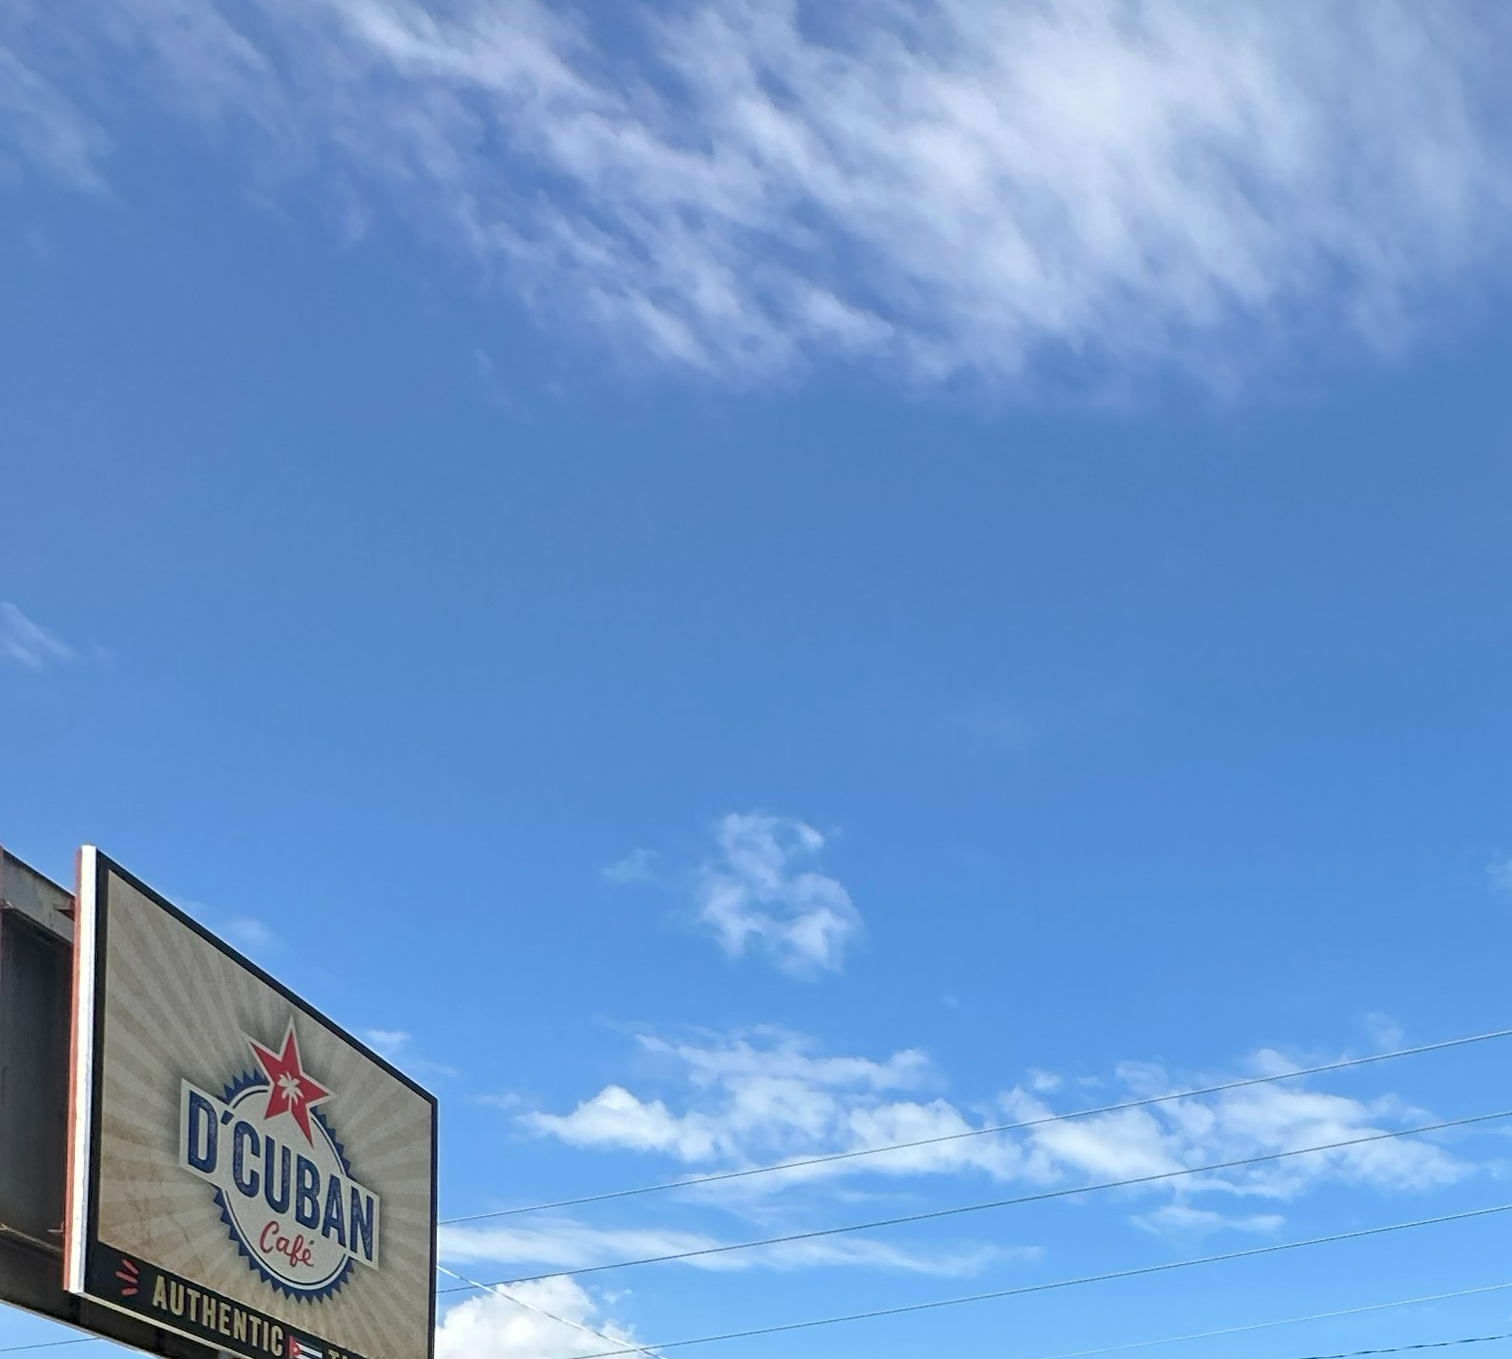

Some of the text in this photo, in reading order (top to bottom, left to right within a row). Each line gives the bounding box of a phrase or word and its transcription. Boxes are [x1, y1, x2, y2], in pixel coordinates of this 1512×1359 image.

[187, 1089, 375, 1263] D'CUBAN
[259, 1219, 315, 1268] Café
[152, 1274, 287, 1357] AUTHENTIC
